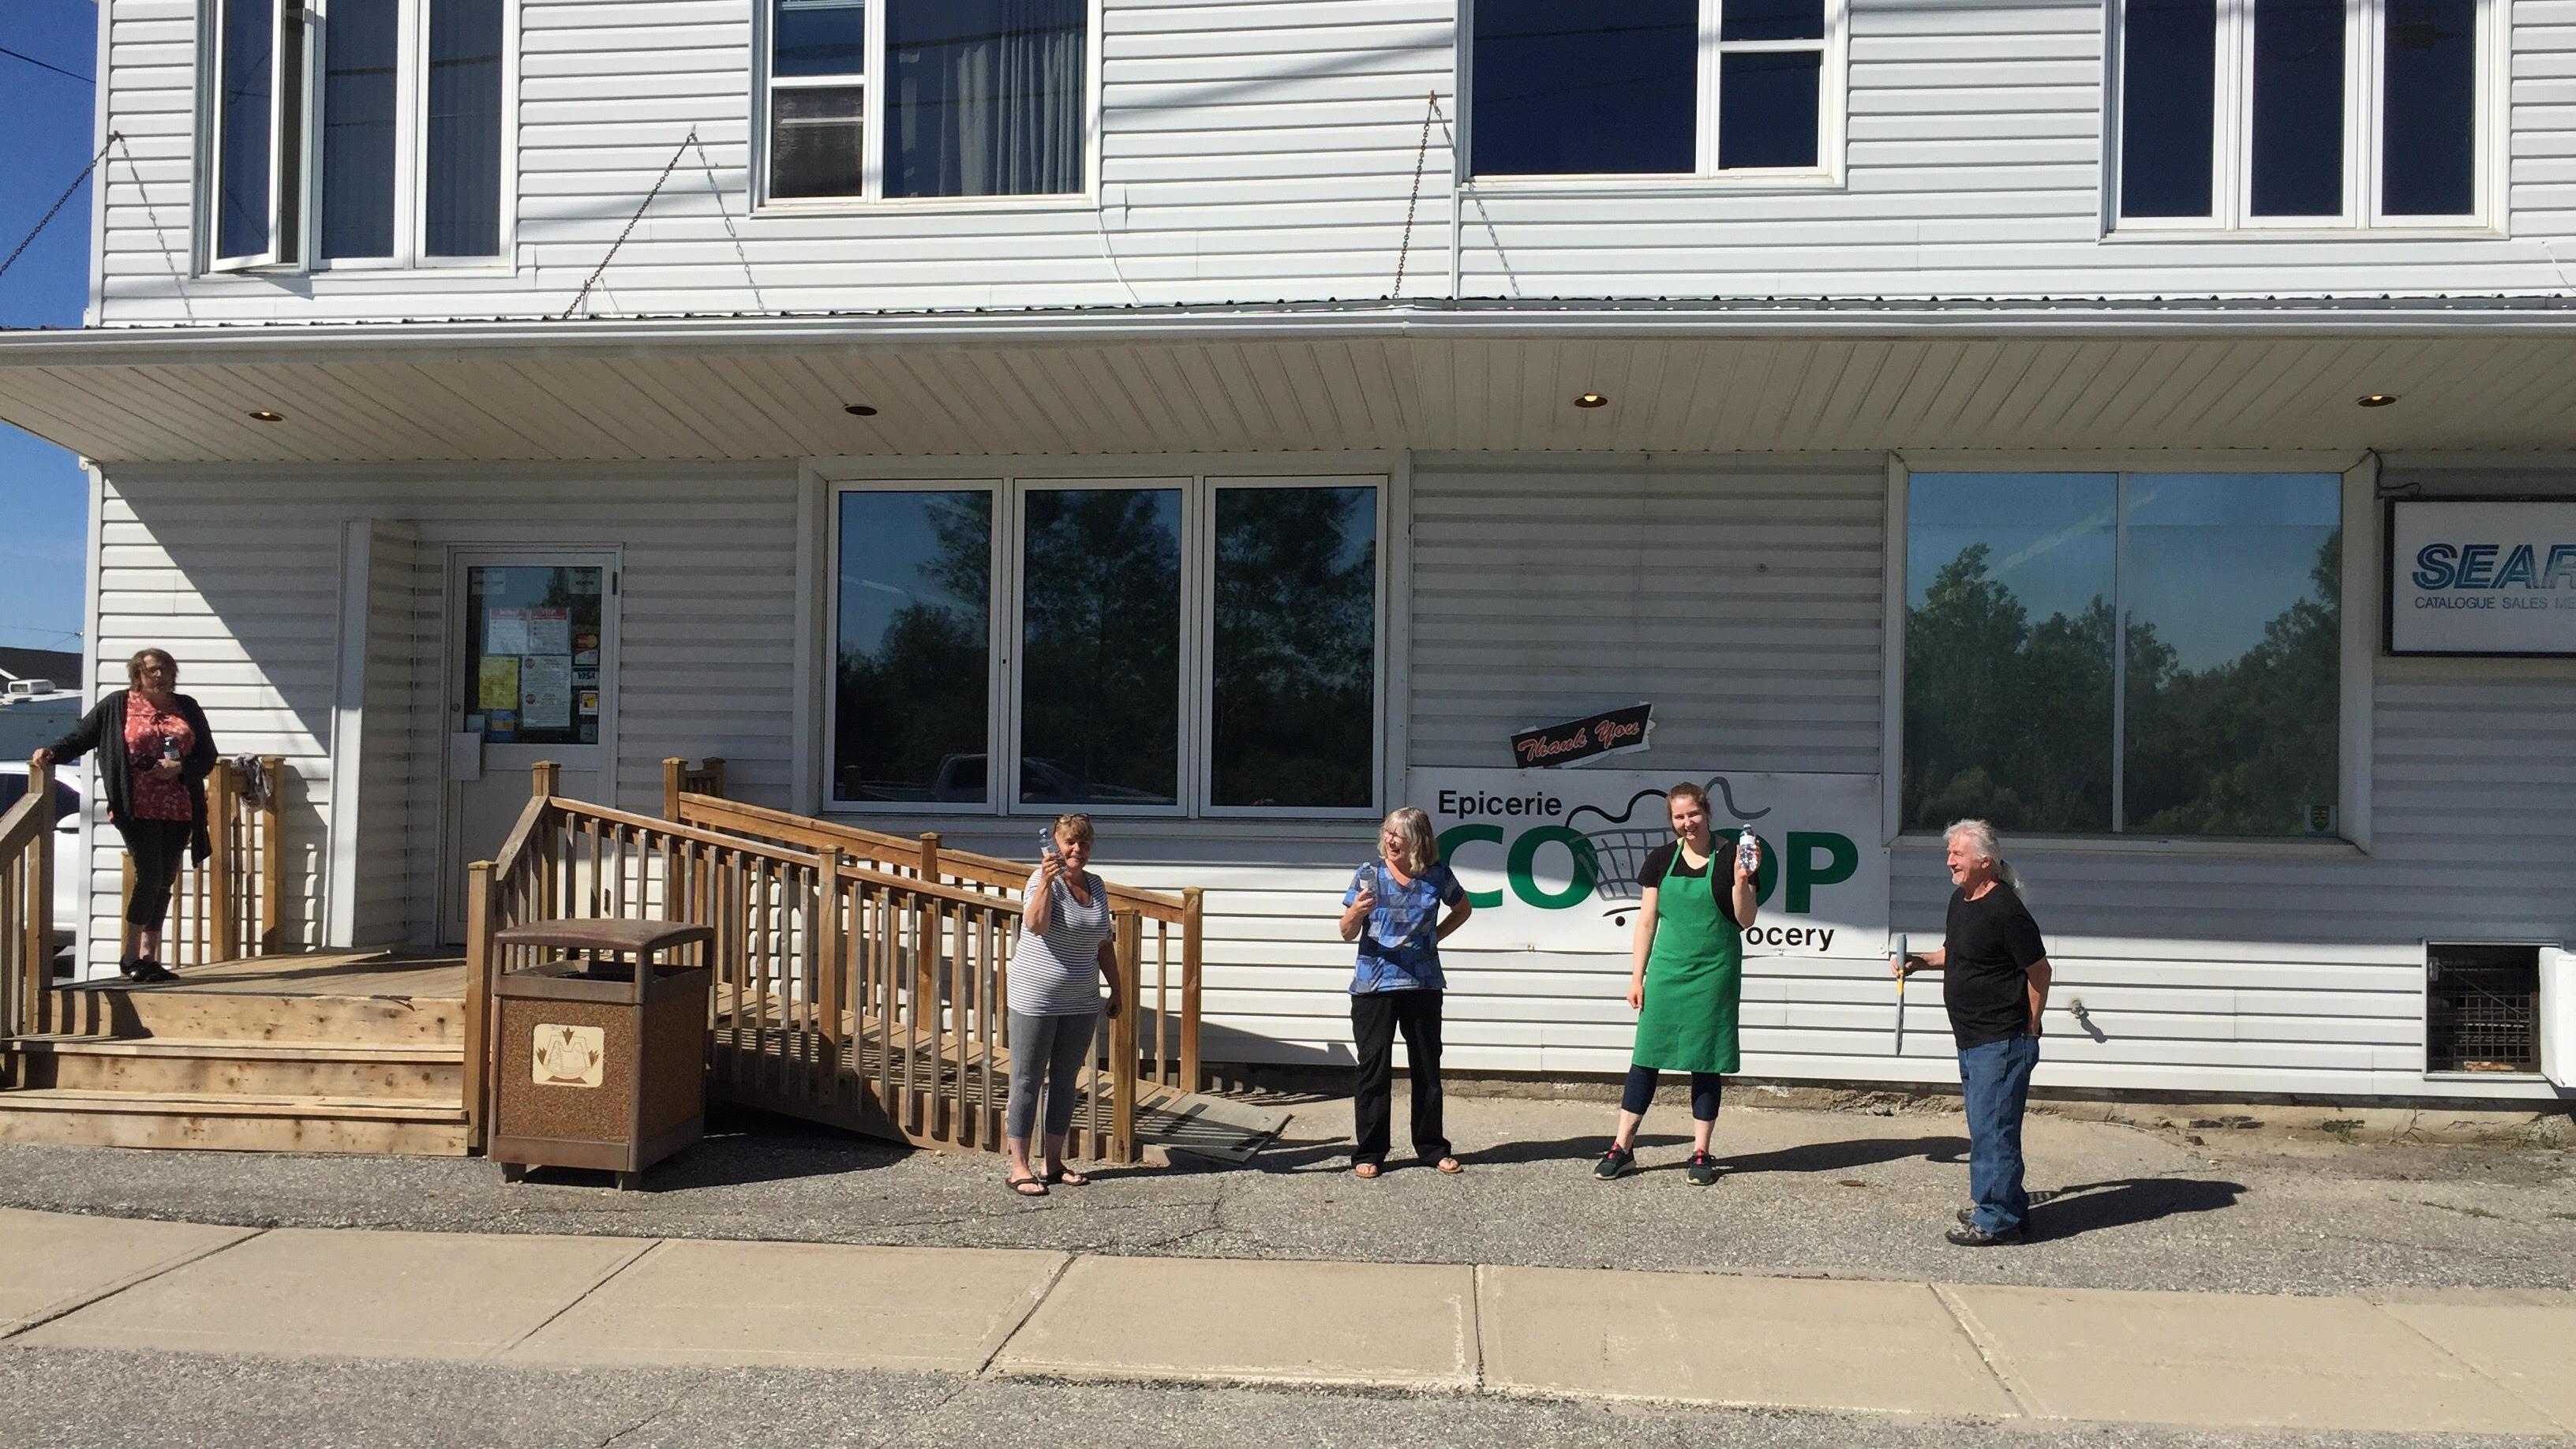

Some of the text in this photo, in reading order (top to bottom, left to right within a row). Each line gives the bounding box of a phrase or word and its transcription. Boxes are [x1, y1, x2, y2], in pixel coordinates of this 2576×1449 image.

[2415, 597, 2496, 609] CATALOGUE
[2503, 597, 2548, 609] SALES
[1518, 720, 1641, 762] Thank You
[1439, 790, 1562, 819] Epicerie
